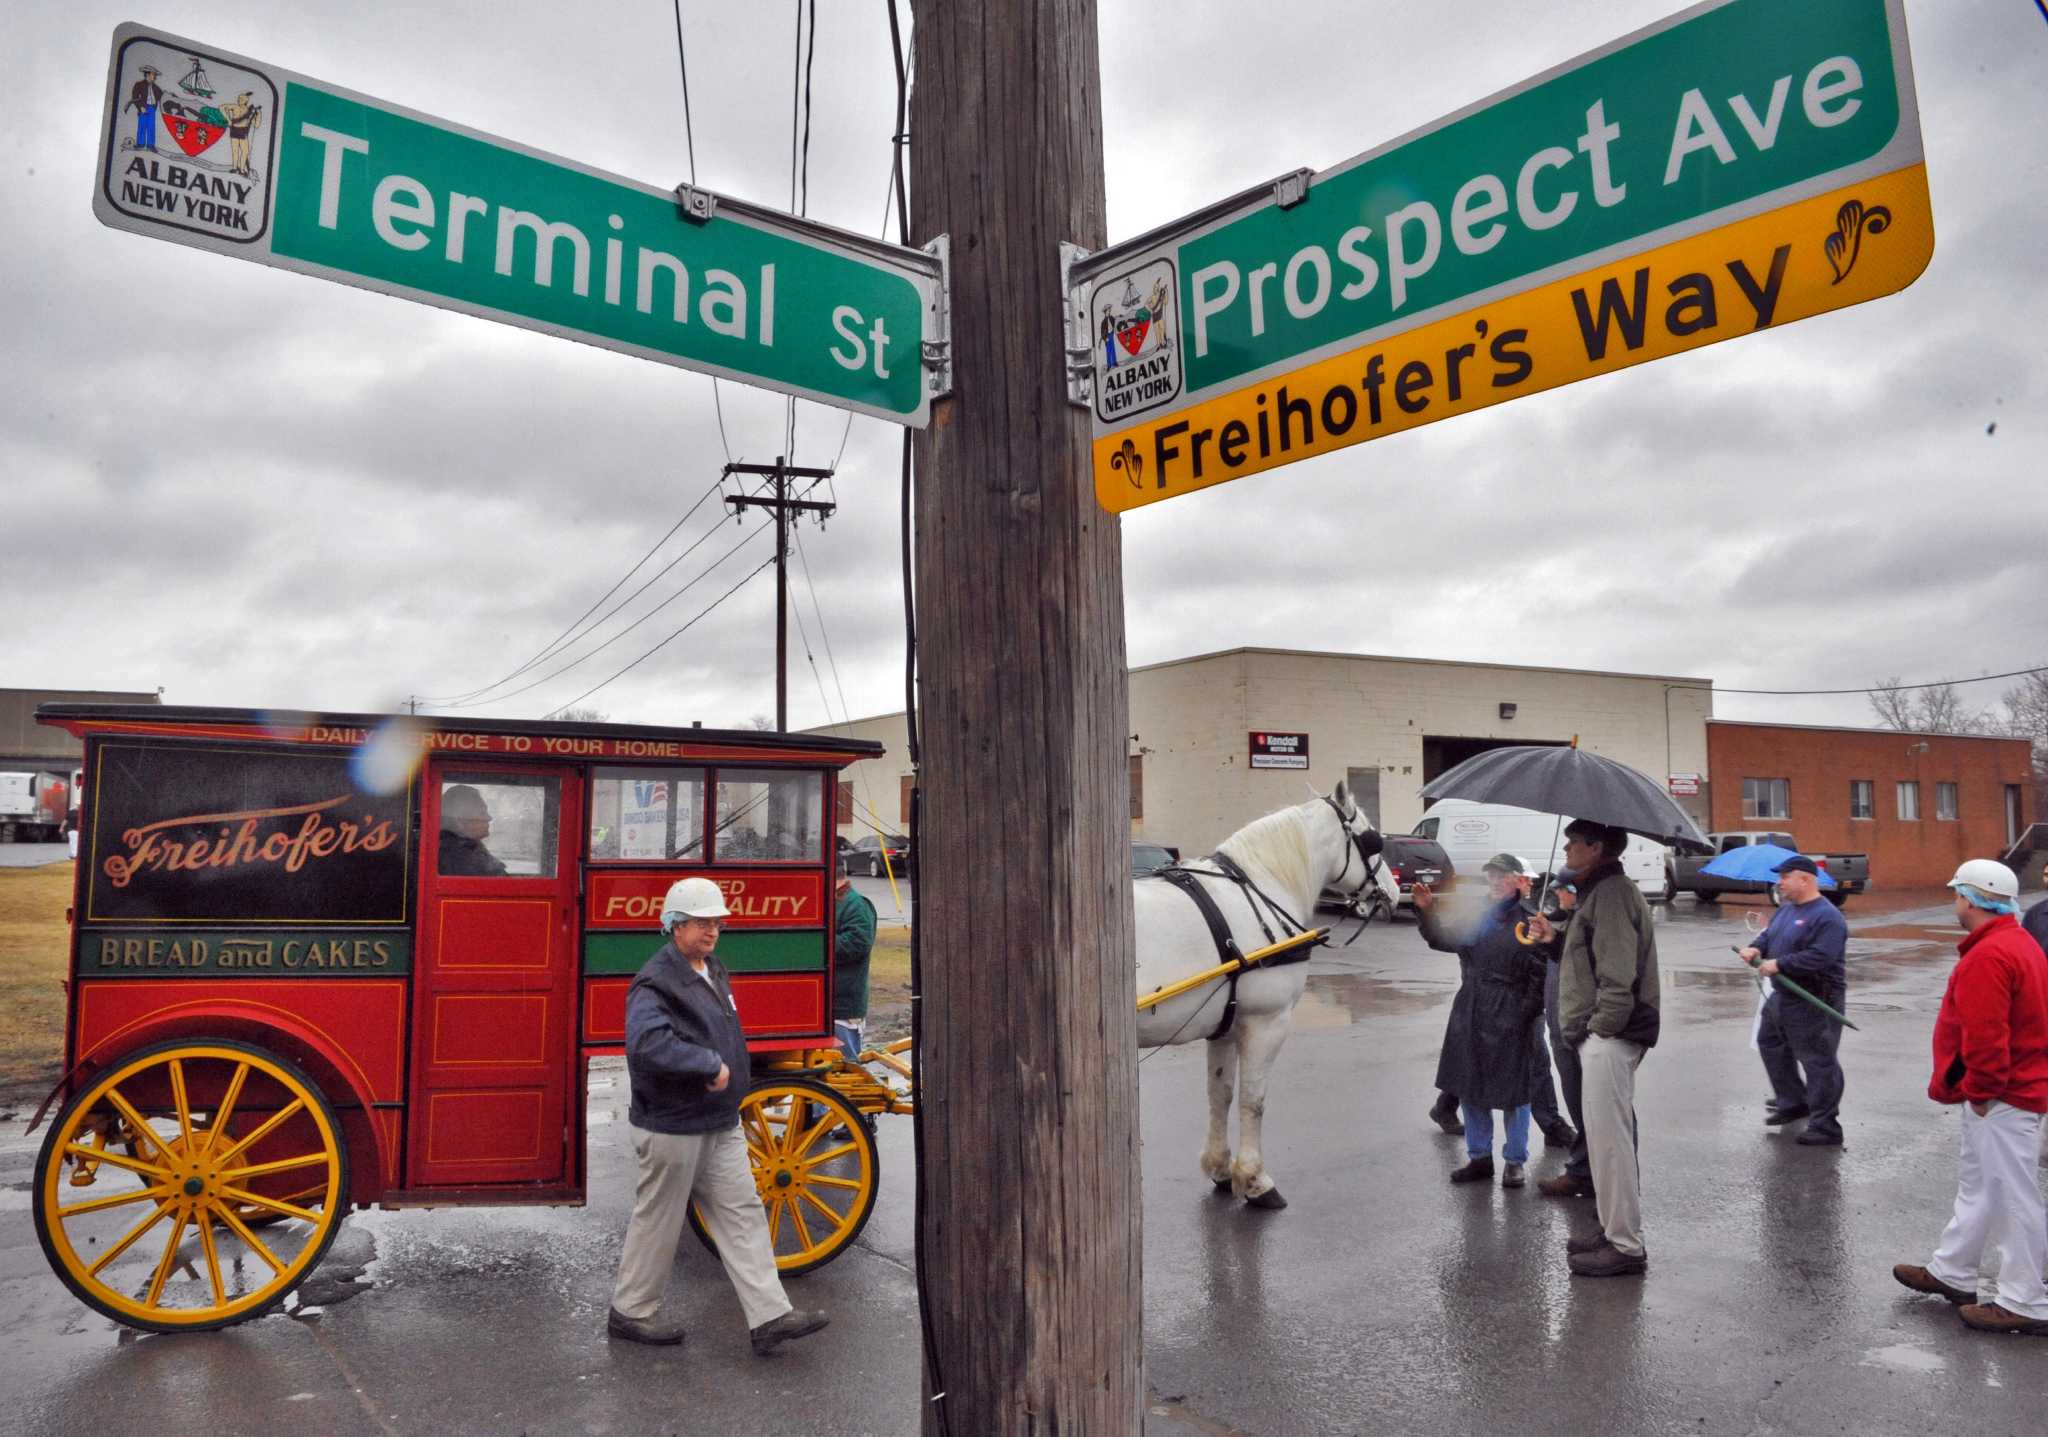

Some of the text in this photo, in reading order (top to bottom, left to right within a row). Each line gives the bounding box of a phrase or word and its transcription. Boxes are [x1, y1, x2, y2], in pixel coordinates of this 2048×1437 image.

[125, 156, 252, 204] ALBANY
[122, 180, 249, 231] NEW YORK
[1190, 55, 1864, 357] Prospect Ave
[301, 122, 890, 379] Terminal St
[1105, 354, 1170, 394] ALBANY
[1154, 244, 1792, 489] Freihofer's Way
[1105, 376, 1173, 414] NEW YORK
[311, 727, 680, 758] DAILY ERVICE TO YOUR HOME
[1267, 735, 1299, 746] Kendall
[104, 795, 398, 888] Freihofer's
[606, 895, 808, 917] FOR ALITY
[100, 938, 391, 969] BREAD and CAKES
